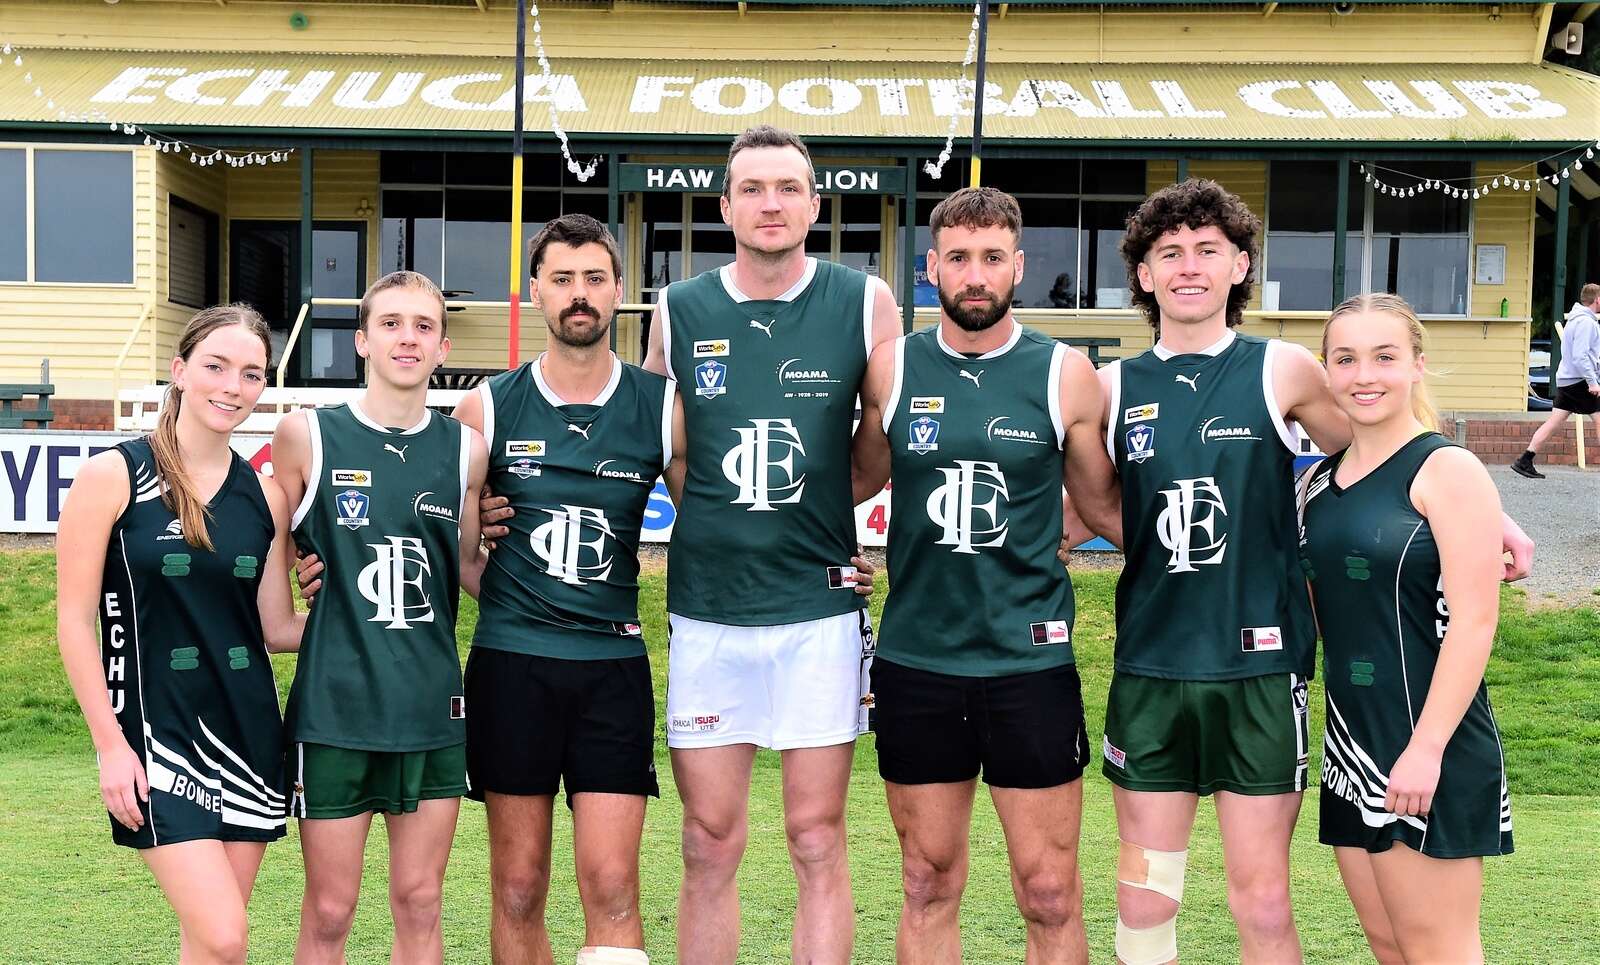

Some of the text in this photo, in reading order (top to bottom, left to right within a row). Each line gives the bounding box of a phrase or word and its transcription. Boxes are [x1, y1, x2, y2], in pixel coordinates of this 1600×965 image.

[90, 67, 1567, 119] ECHUCA FOOTBALL CLUB
[785, 370, 829, 379] MOAMA
[993, 428, 1038, 440] MOAMA
[1207, 427, 1252, 438] MOAMA
[601, 470, 641, 480] MOAMA
[2, 445, 113, 522] YE
[420, 503, 453, 517] MOAMA
[694, 714, 720, 725] ISUZU
